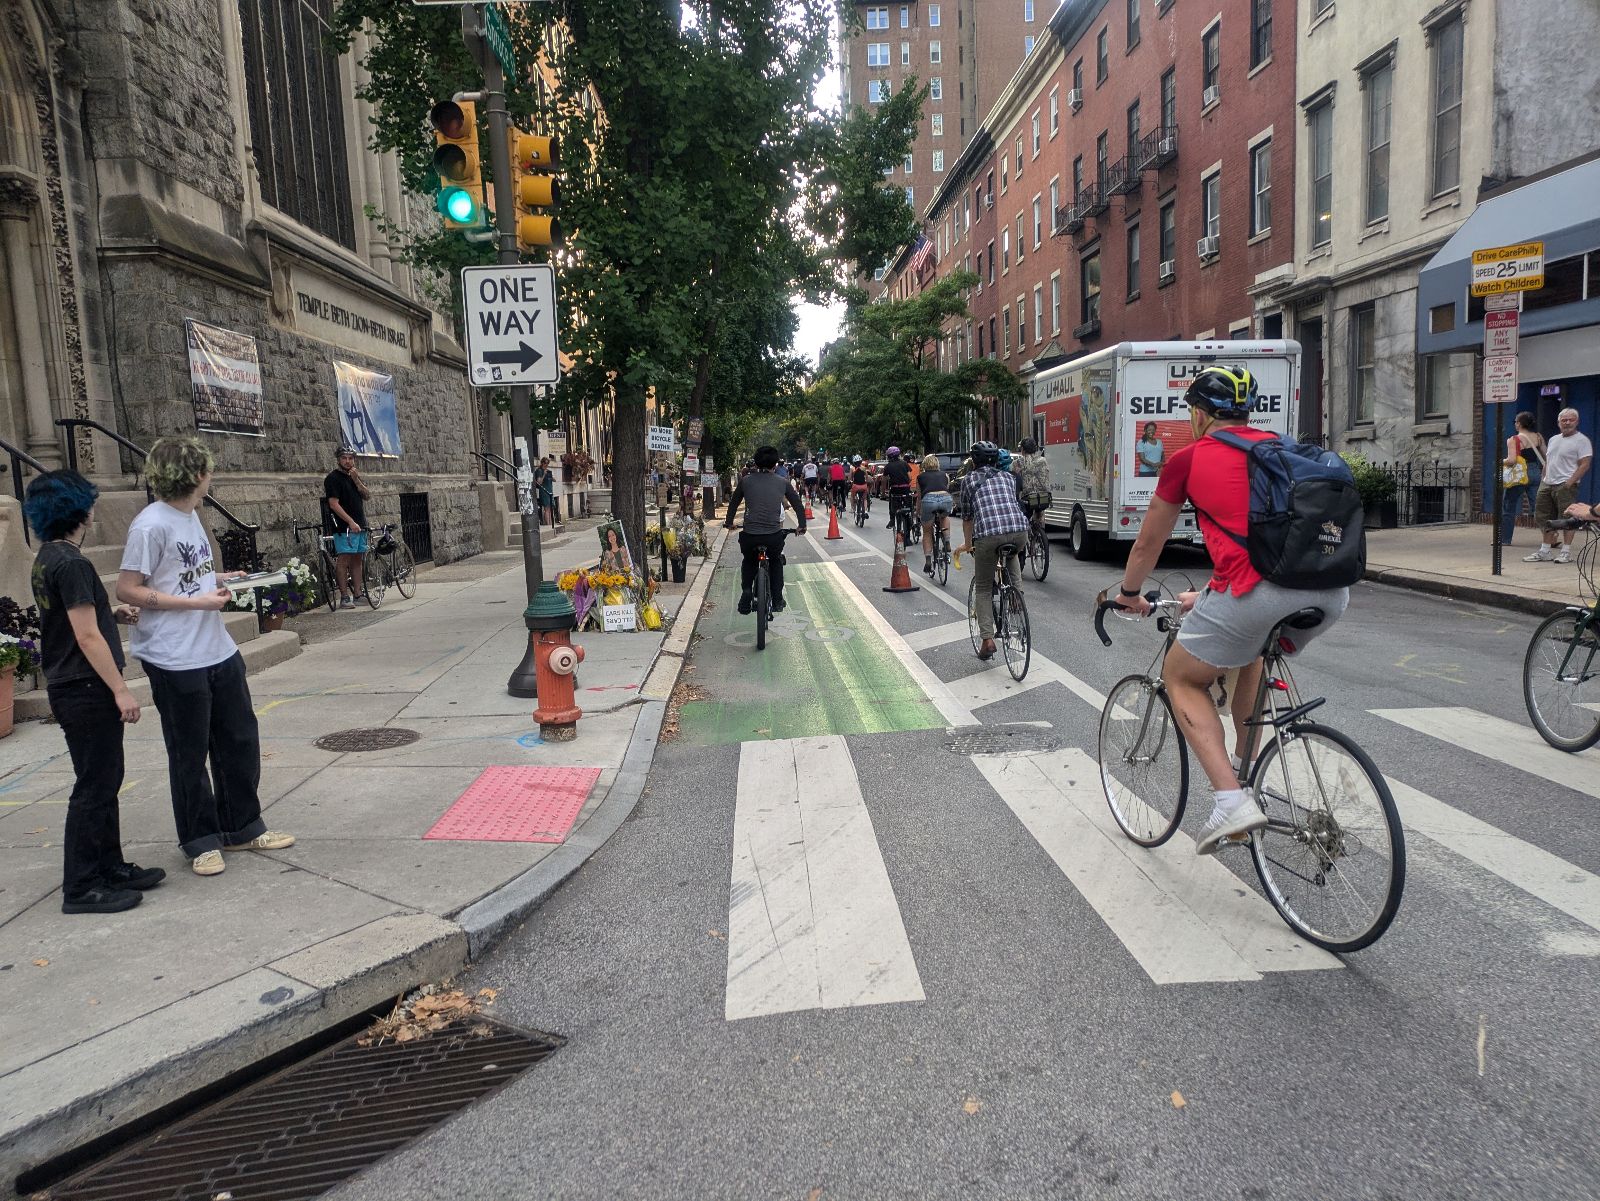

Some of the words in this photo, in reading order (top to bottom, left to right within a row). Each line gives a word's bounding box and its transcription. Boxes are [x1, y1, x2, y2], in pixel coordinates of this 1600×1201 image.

[1477, 252, 1497, 262] Drive
[1499, 245, 1539, 259] CarePhilly
[1475, 268, 1496, 279] SPEED
[1497, 261, 1517, 278] 25
[1519, 261, 1540, 273] LIMIT
[480, 277, 539, 304] ONE
[1475, 281, 1502, 293] Watch
[1504, 278, 1540, 290] Children
[297, 292, 329, 320] TEMPLE
[330, 304, 350, 328] BETH
[387, 327, 408, 349] ISRAEL
[479, 309, 541, 336] WAY
[1488, 319, 1516, 328] STOPPING
[1494, 338, 1510, 346] TIME
[1488, 359, 1513, 367] LOADING
